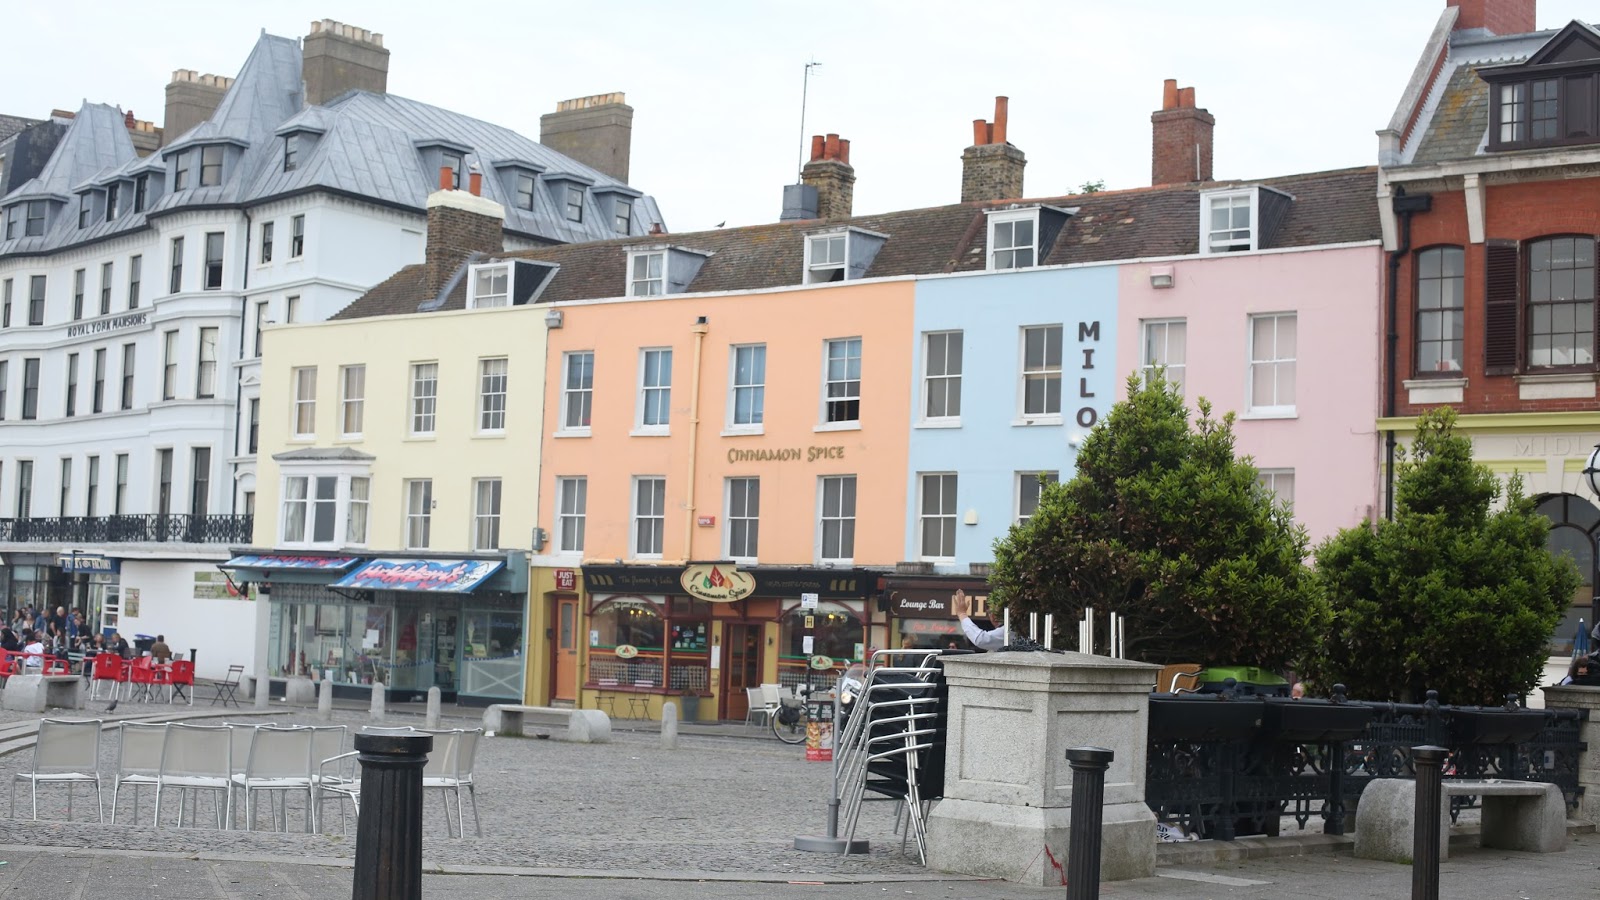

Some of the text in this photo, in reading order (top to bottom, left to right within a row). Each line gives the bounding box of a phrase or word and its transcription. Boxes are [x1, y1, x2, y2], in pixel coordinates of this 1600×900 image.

[67, 313, 147, 338] ROYAL YORK MANSIONS
[1075, 320, 1101, 428] MILO
[727, 446, 845, 464] CINNAMON SPICE
[558, 571, 574, 579] JUST
[561, 578, 574, 587] EAT
[690, 584, 747, 599] Cinnamon Spice
[900, 598, 927, 611] Lounge
[928, 599, 945, 609] Bar
